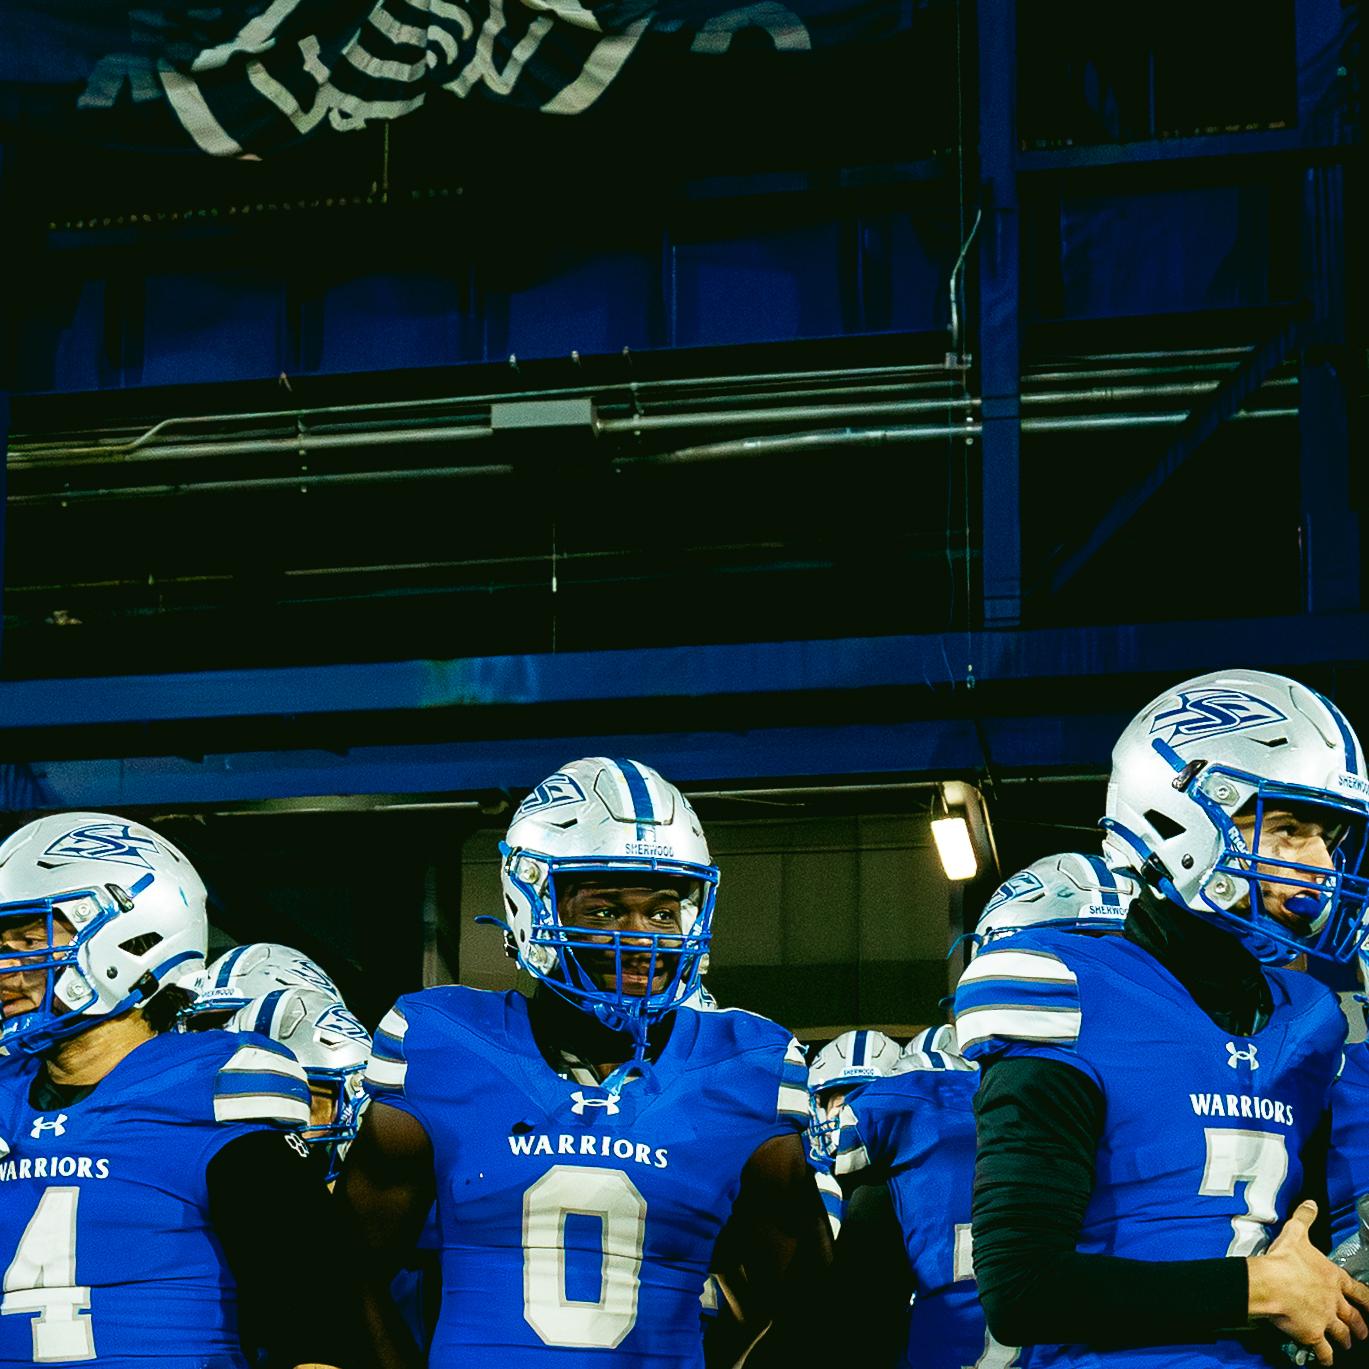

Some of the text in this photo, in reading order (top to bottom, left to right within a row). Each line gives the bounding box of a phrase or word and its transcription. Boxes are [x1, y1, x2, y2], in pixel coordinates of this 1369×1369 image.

[508, 1134, 669, 1169] WARRIORS
[1188, 1093, 1294, 1126] WARRIORS
[522, 1164, 647, 1349] 0
[1198, 1127, 1289, 1258] 7
[0, 1186, 97, 1363] 4
